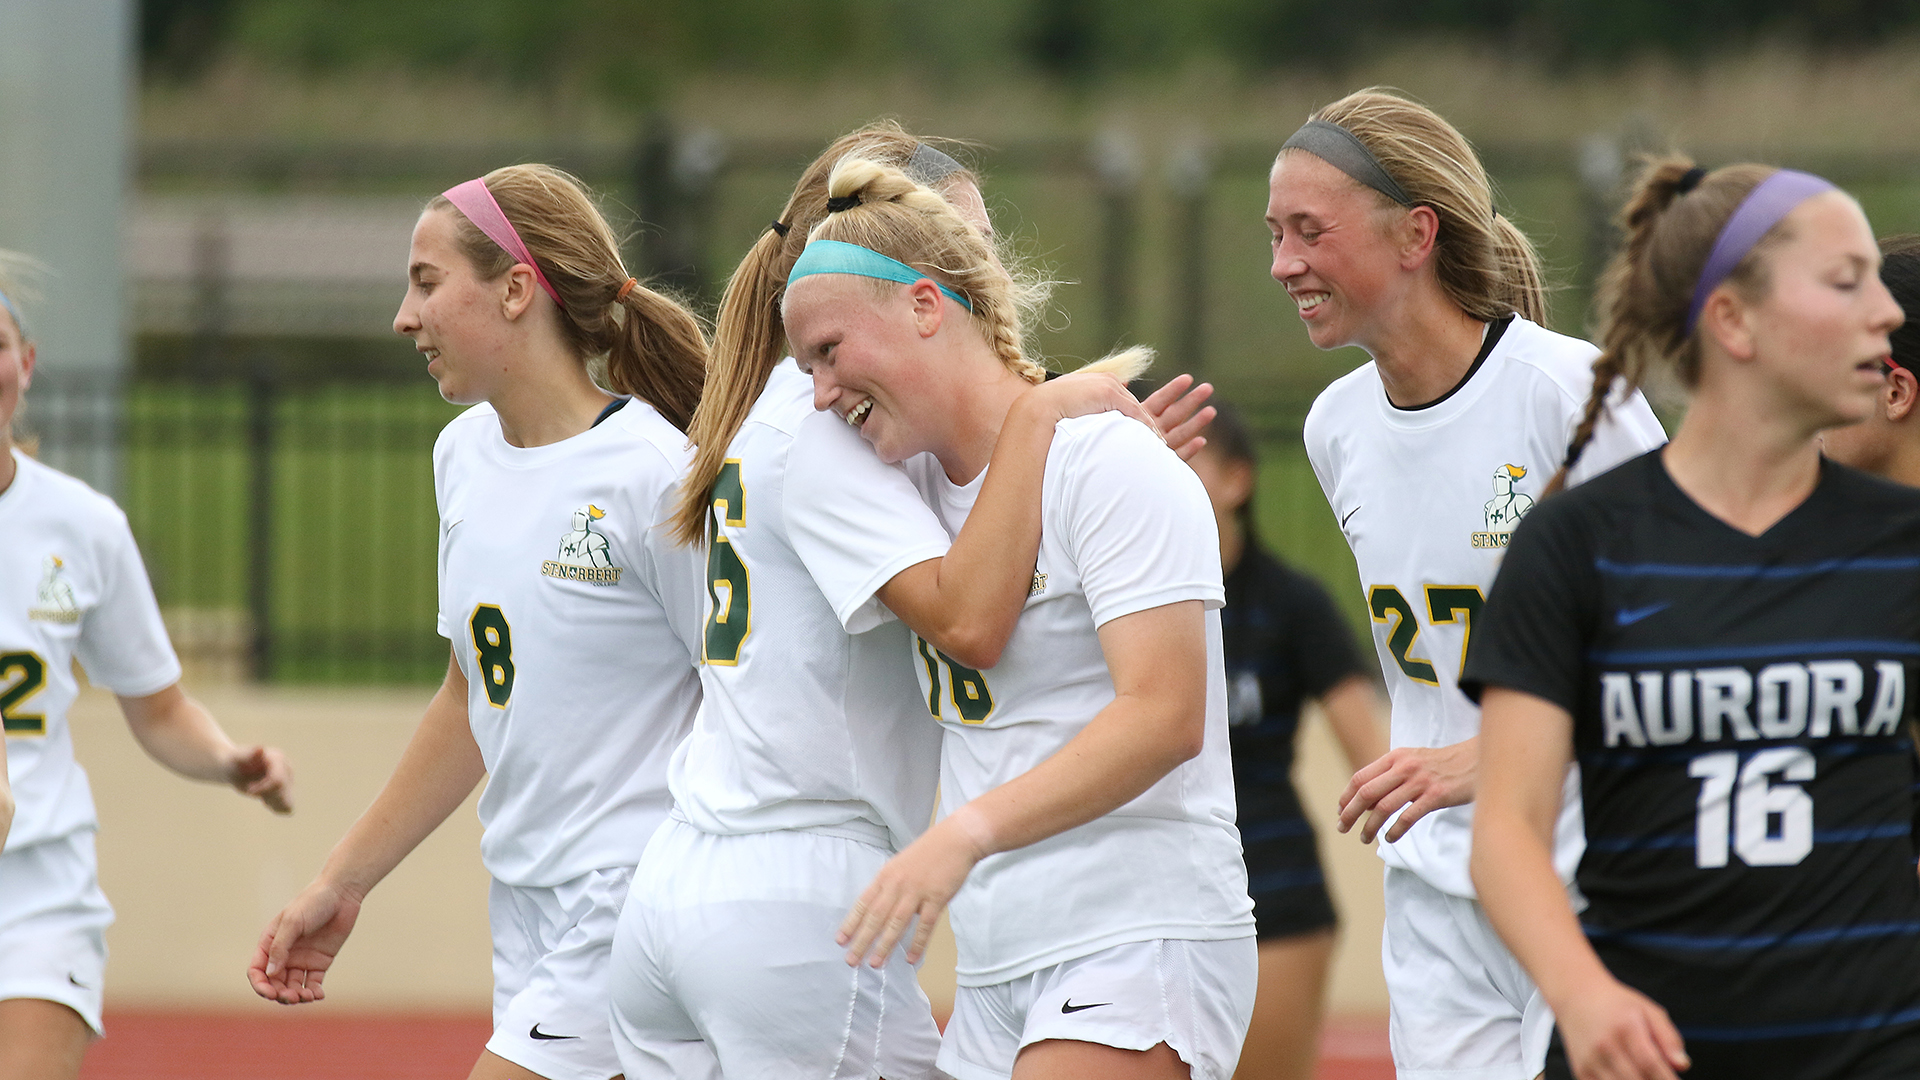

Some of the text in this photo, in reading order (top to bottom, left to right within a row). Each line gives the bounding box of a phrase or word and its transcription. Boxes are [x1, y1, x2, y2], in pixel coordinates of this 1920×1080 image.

[469, 602, 516, 709] 8
[1368, 583, 1488, 688] 27
[0, 649, 48, 735] 2
[1600, 659, 1906, 748] AURORA
[1687, 746, 1817, 869] 16
